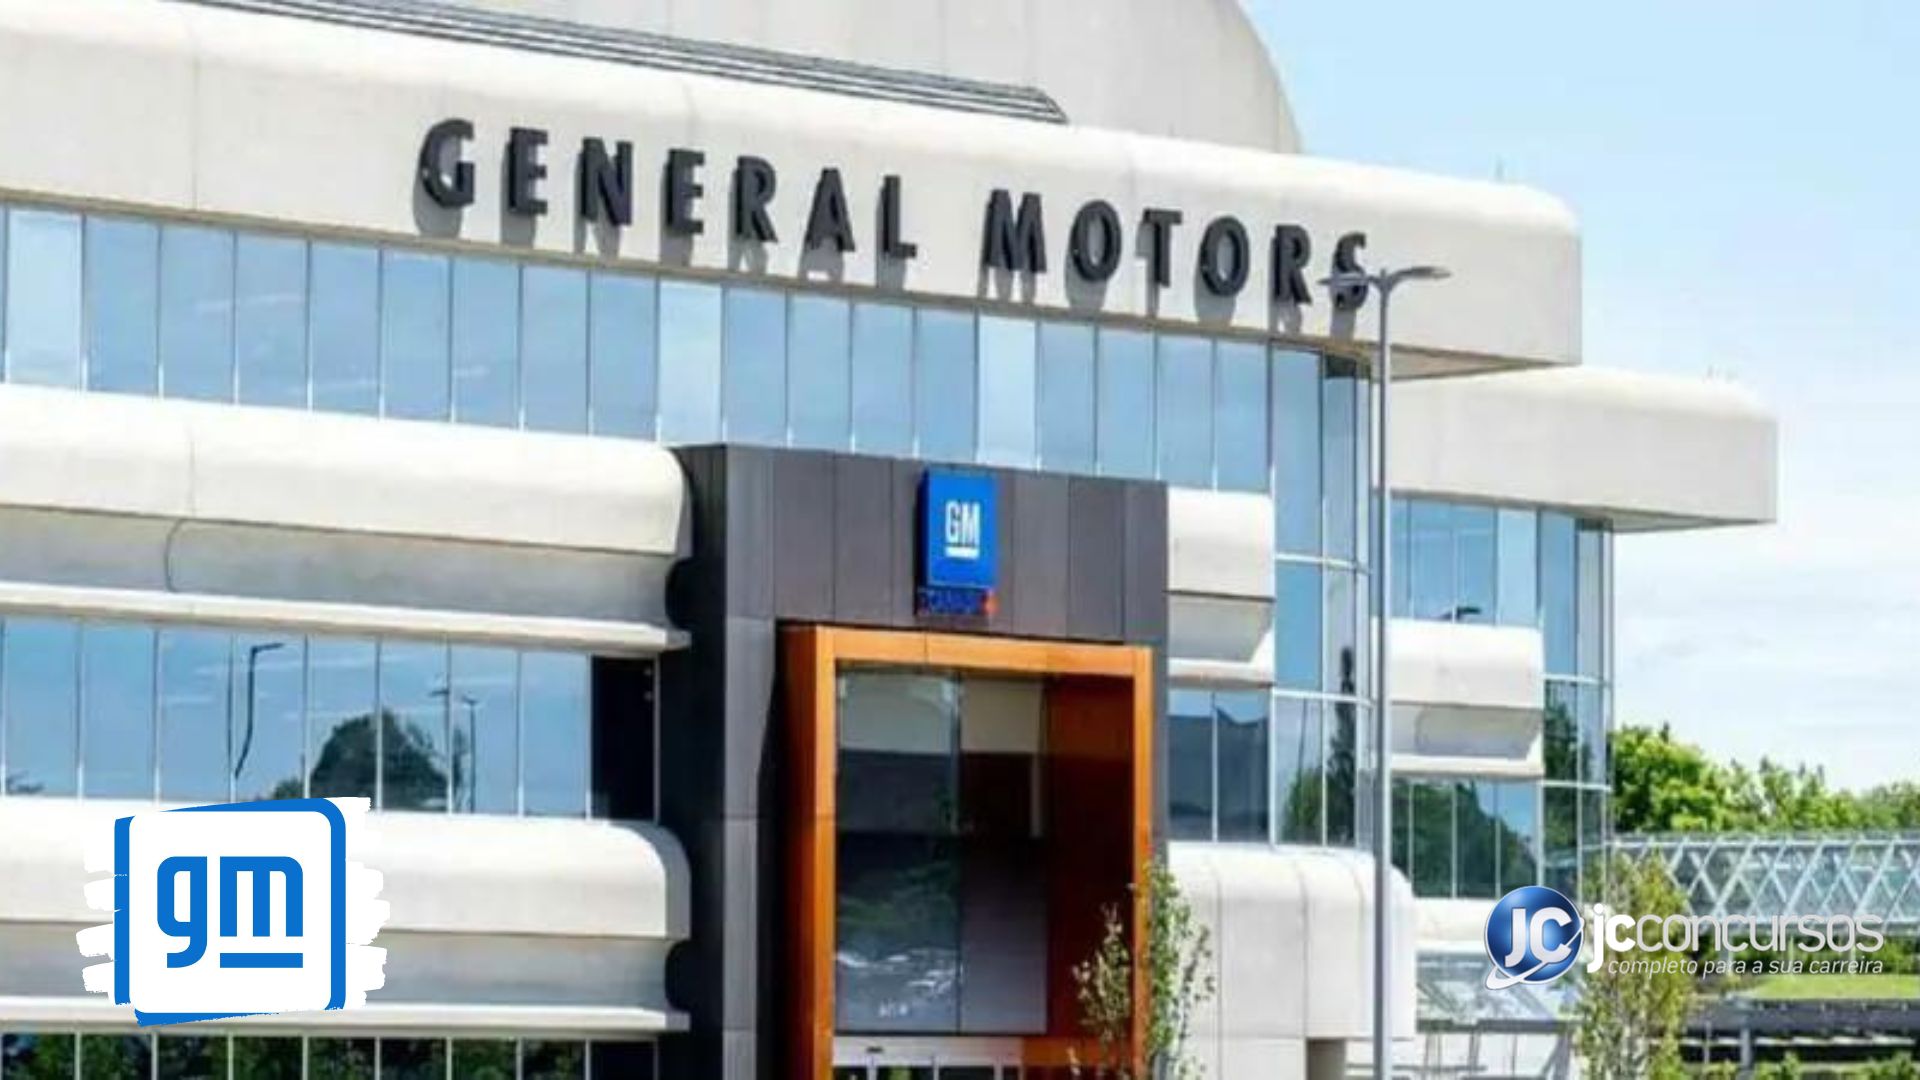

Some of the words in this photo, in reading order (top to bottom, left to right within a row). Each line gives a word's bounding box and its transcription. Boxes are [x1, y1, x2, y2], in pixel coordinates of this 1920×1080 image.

[418, 118, 918, 259] GENERAL
[984, 189, 1368, 310] MOTORS
[945, 500, 980, 546] GM
